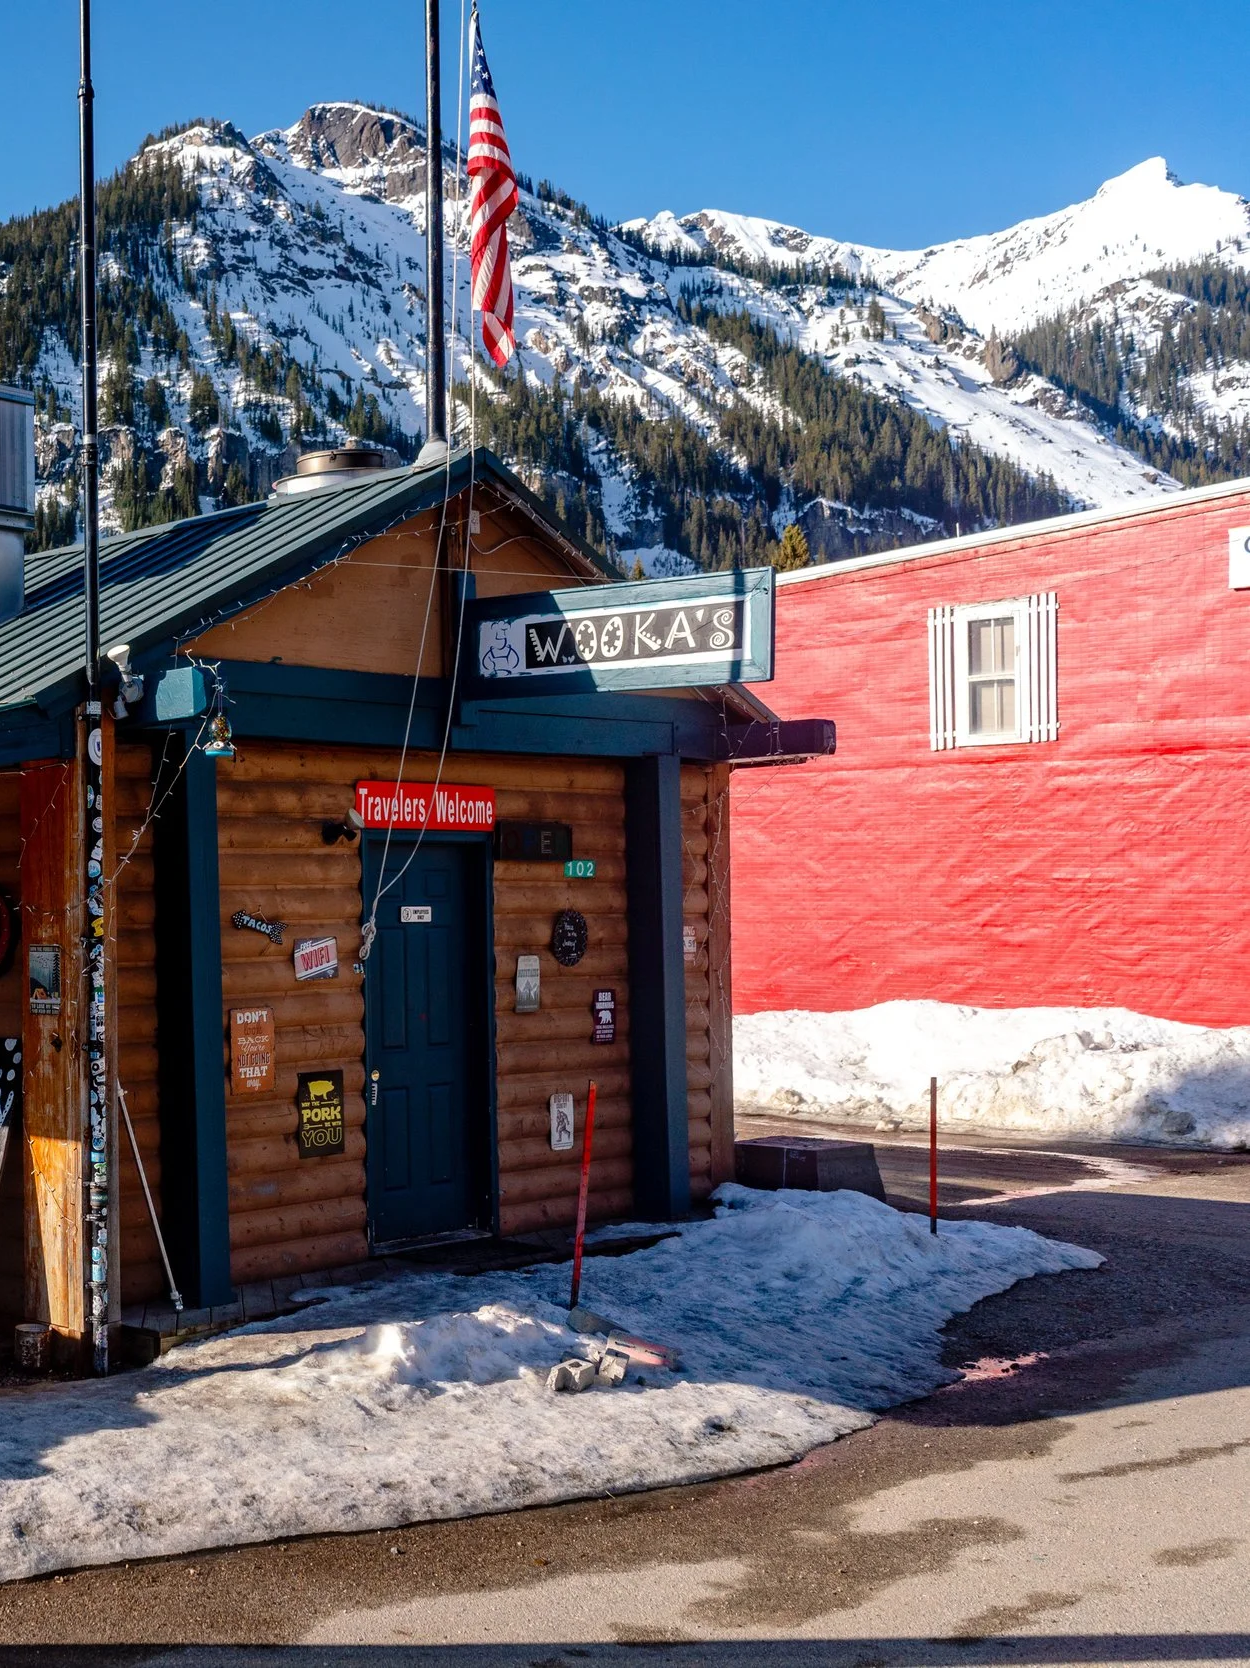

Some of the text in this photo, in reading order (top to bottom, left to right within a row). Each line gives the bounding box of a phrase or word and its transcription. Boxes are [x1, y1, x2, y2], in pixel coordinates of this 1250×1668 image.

[529, 608, 736, 664] WOOKA'S
[359, 787, 493, 825] Travelers Welcome
[567, 862, 594, 877] 102
[240, 914, 272, 934] TACOS
[300, 945, 330, 971] WIFI
[236, 1010, 268, 1024] DON'T
[237, 1035, 270, 1045] BACK
[239, 1065, 268, 1079] THAT
[301, 1105, 342, 1123] PORK
[301, 1126, 343, 1148] YOU
